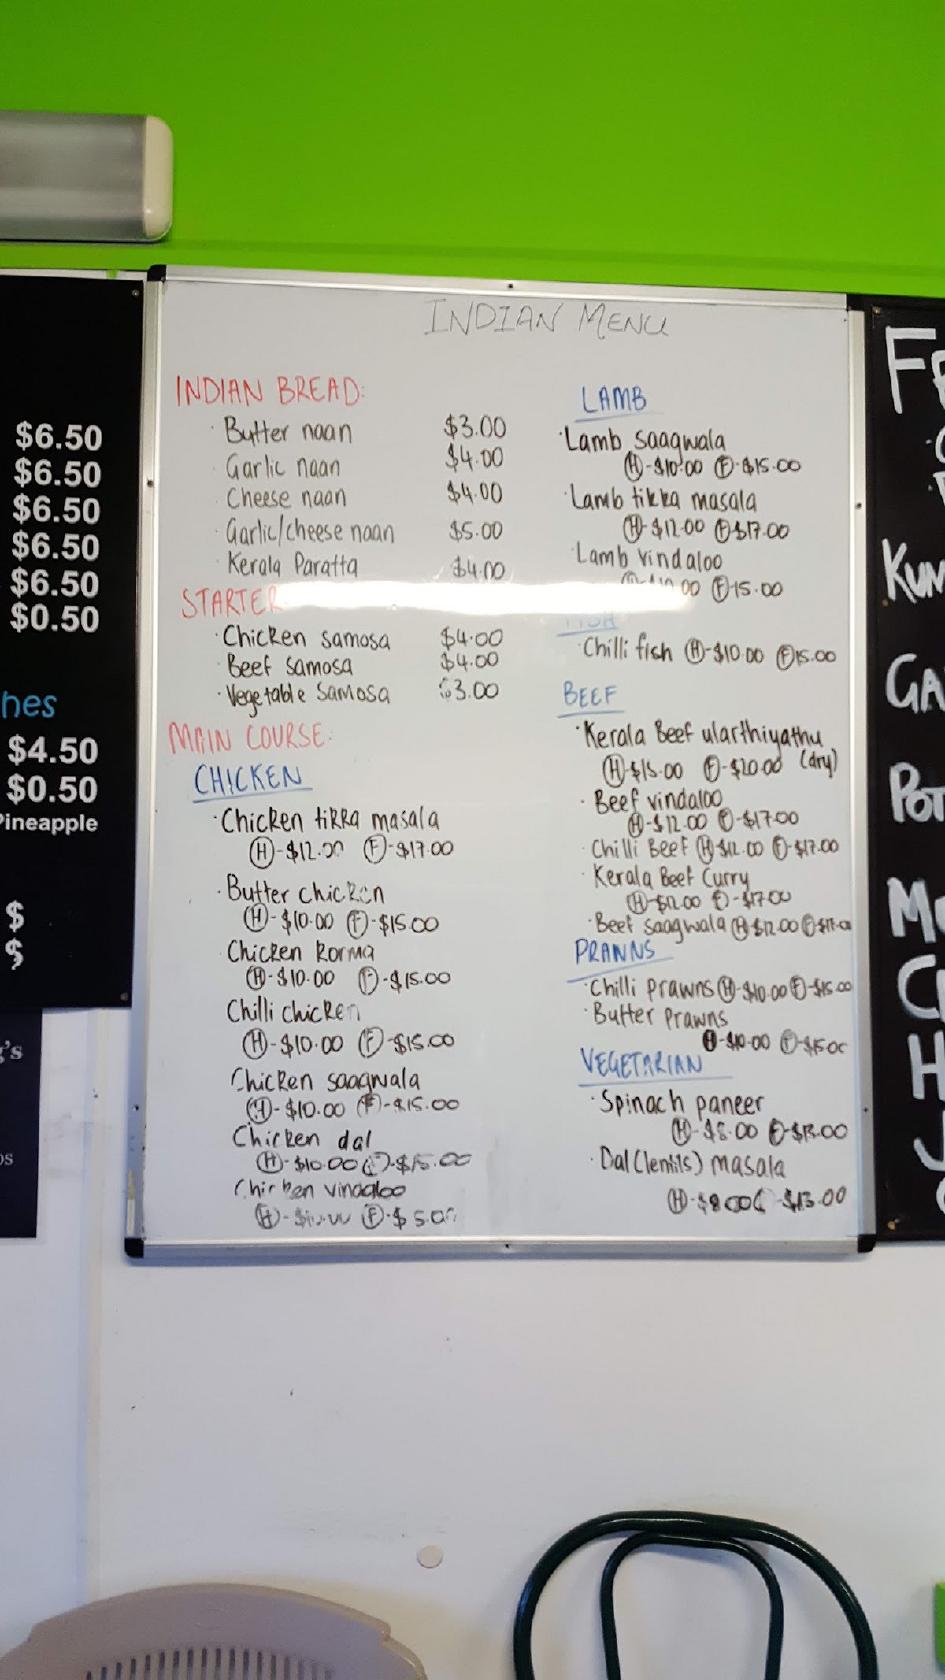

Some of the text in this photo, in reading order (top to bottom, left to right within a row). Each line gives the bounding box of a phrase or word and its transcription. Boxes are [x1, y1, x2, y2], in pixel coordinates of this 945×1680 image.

[424, 298, 669, 339] INDIAN MENU
[175, 375, 263, 407] INDIAN
[582, 385, 647, 413] LAMB
[15, 420, 103, 451] $6.50
[224, 413, 506, 447] Butter naan $3.00
[565, 424, 622, 453] Lamb
[14, 456, 102, 488] $6.50
[226, 443, 504, 480] Garlic naan $4.00
[12, 492, 100, 525] $6.50
[227, 482, 503, 509] Cheese naan $4.00
[570, 483, 757, 513] Lamb tikka masala
[11, 529, 100, 561] $6.50
[351, 521, 394, 544] naan
[450, 520, 503, 543] $5.00
[228, 550, 281, 578] Kerala
[294, 551, 358, 578] Paratta
[577, 541, 722, 572] Lamb vindaloo
[10, 565, 99, 598] $6.50
[10, 601, 99, 633] $0.50
[223, 624, 305, 648] Chicken
[440, 626, 503, 651] $4.00
[583, 636, 628, 660] Chilli
[636, 632, 673, 662] fish
[227, 651, 499, 678] Beef samosa $4.00
[1, 690, 57, 719] hes
[227, 683, 306, 719] Vegetable
[563, 680, 617, 708] BEEF
[168, 721, 232, 755] MAIN
[584, 720, 646, 749] Kerala
[655, 718, 693, 743] Beef
[8, 733, 98, 766] $4.50
[800, 748, 838, 778] (dry)
[6, 773, 98, 805] $0.50
[194, 763, 302, 795] CHICKEN
[594, 787, 723, 815] Beef vindaloo
[221, 807, 303, 834] Chicken
[371, 806, 440, 834] masala
[592, 838, 637, 860] Chilli
[649, 835, 689, 860] Beef
[227, 873, 290, 904] Butter
[594, 863, 652, 889] Kerala
[660, 866, 695, 888] Beef
[595, 911, 633, 934] Beef
[227, 939, 302, 963] Chicken
[590, 975, 636, 997] Chilli
[226, 995, 274, 1023] Chilli
[594, 1002, 654, 1027] Butter
[580, 1047, 703, 1078] VEGETARIAN
[231, 1066, 313, 1093] Chicken
[600, 1089, 765, 1121] Spinach paneer
[233, 1122, 372, 1151] Chicken dal
